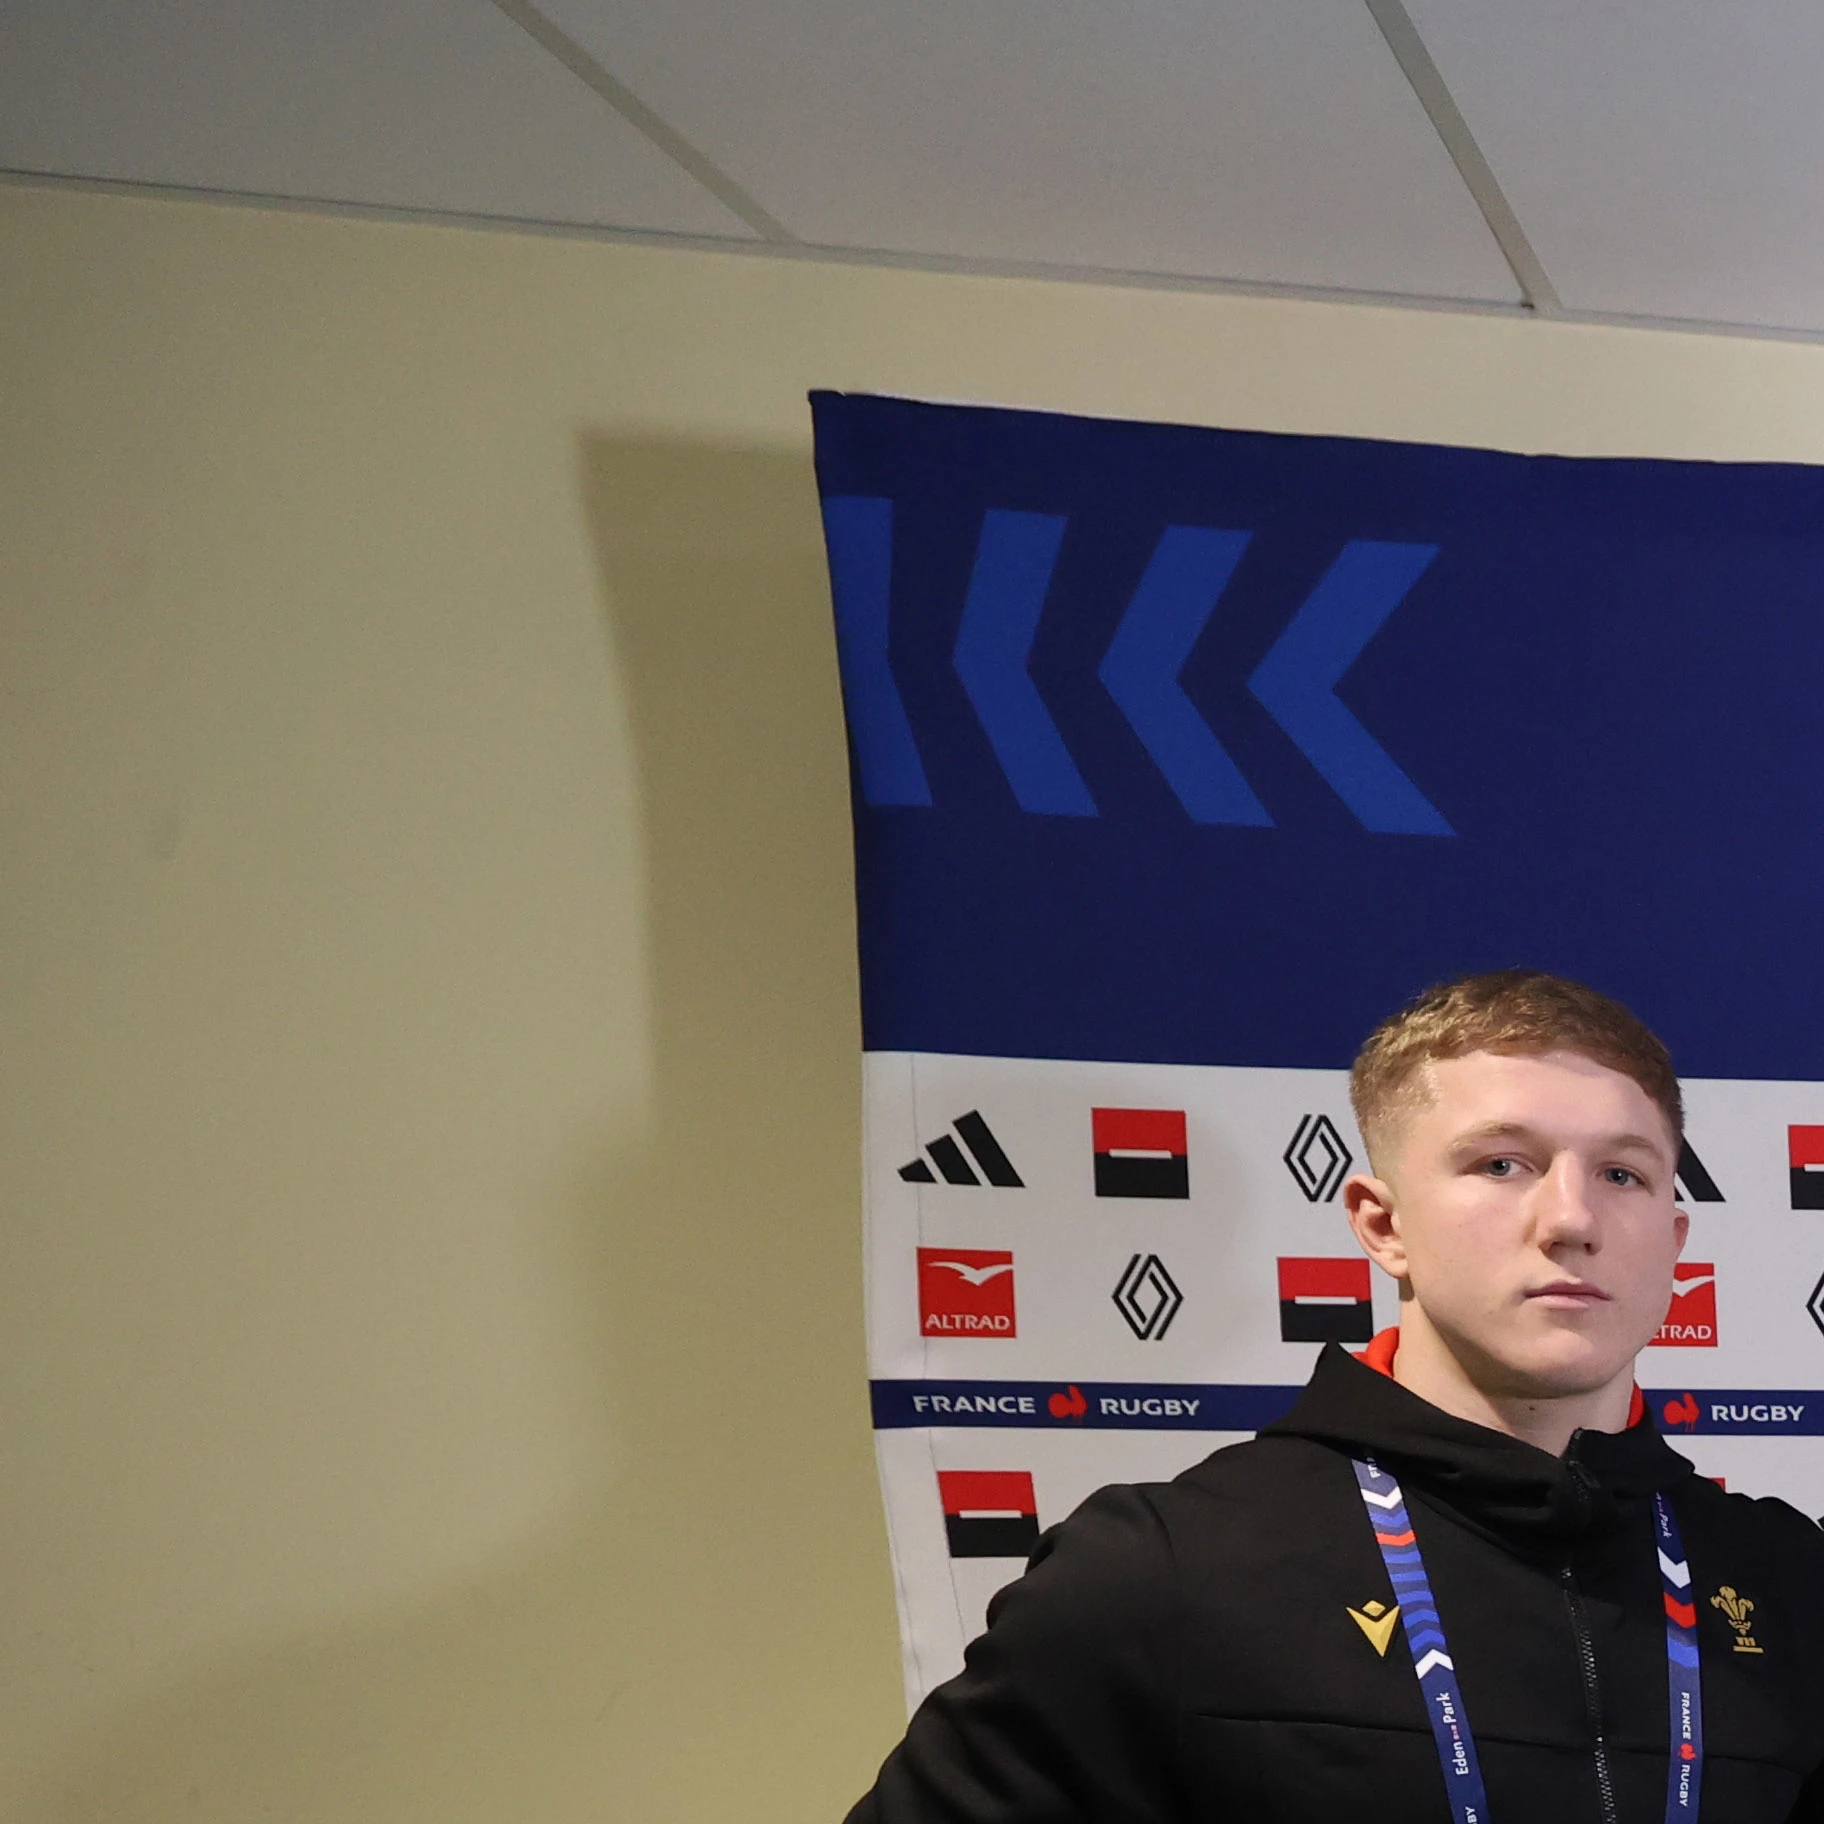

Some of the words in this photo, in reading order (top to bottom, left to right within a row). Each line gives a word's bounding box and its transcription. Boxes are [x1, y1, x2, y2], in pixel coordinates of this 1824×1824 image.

[925, 1313, 1011, 1331] ALTRAD
[1654, 1323, 1713, 1341] TRAD
[913, 1395, 1036, 1414] FRANCE
[1099, 1398, 1200, 1416] RUGBY
[1711, 1404, 1805, 1422] RUGBY
[1435, 1691, 1457, 1724] Park
[1680, 1691, 1691, 1740] FRANCE
[1451, 1740, 1469, 1775] Eden
[1679, 1764, 1691, 1807] RUGBY
